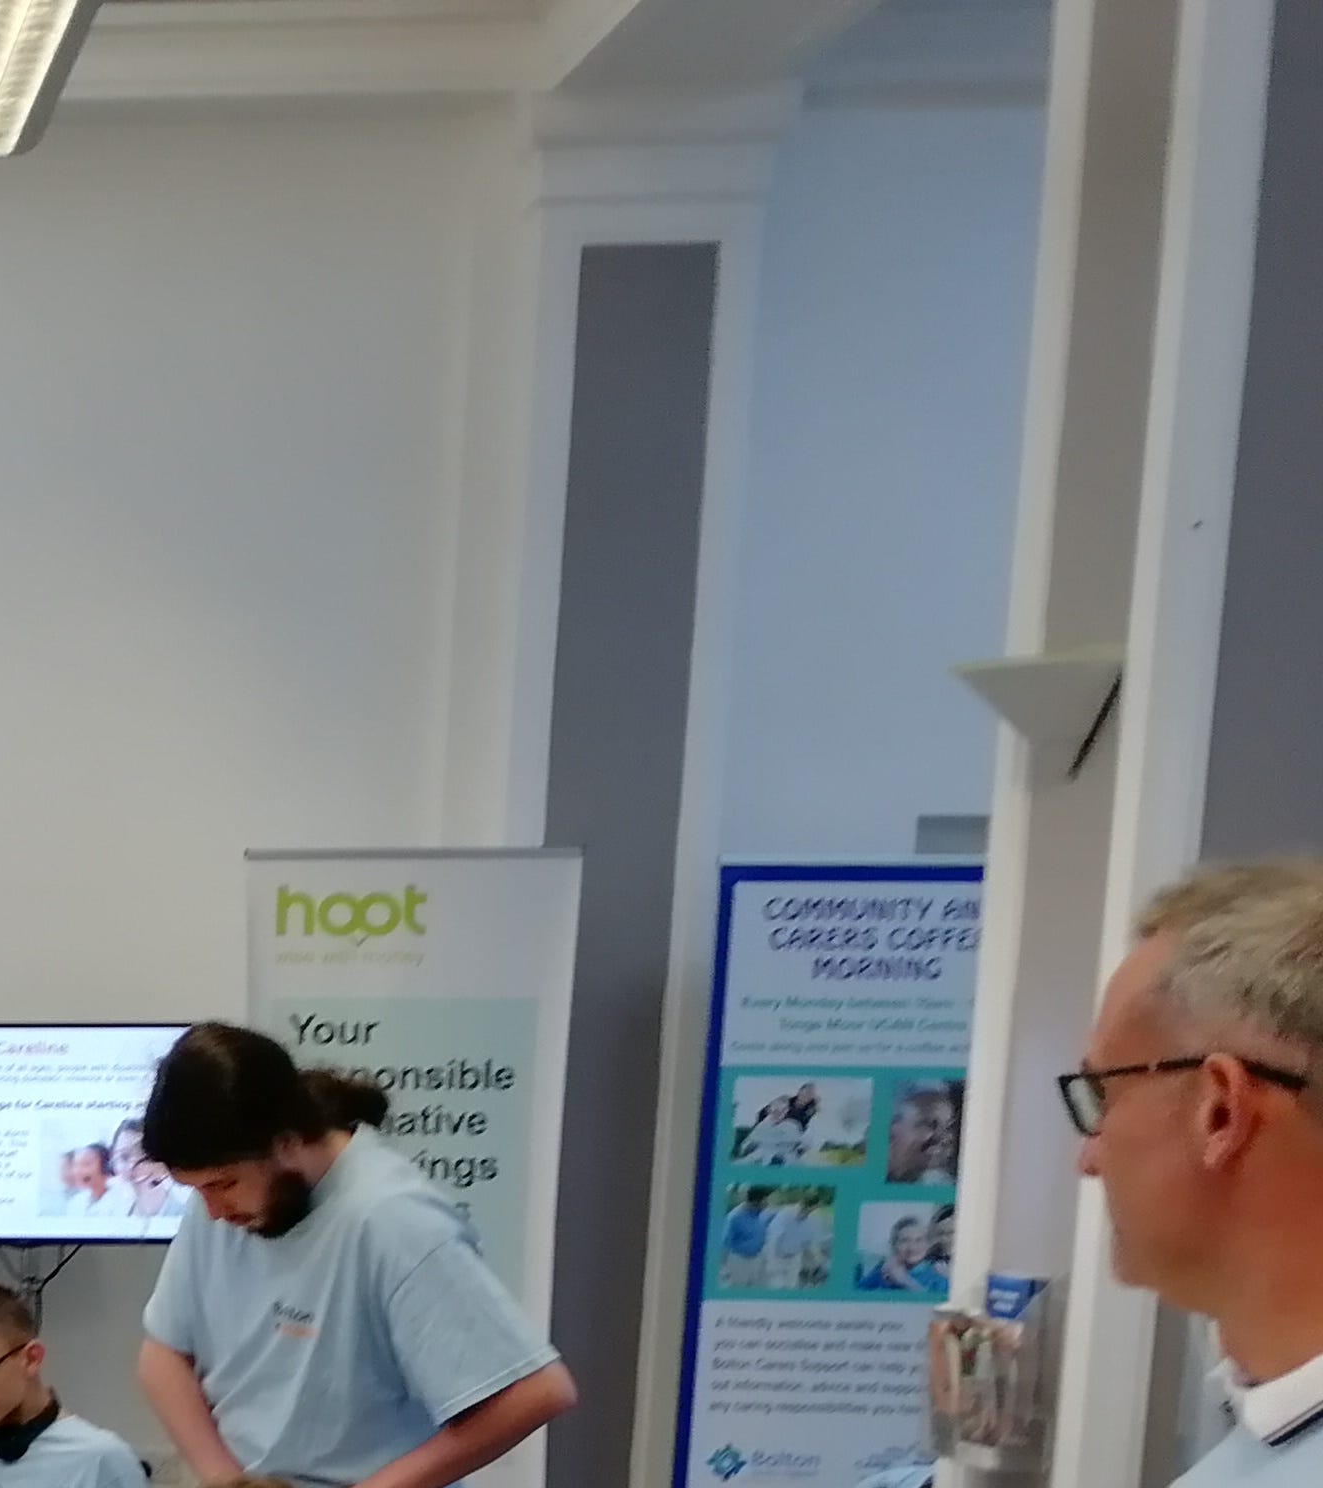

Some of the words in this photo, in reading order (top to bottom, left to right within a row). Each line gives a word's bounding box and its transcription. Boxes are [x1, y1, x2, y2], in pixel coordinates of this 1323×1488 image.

[276, 884, 427, 936] hoot
[289, 1012, 380, 1046] Your
[353, 1059, 516, 1091] onsible
